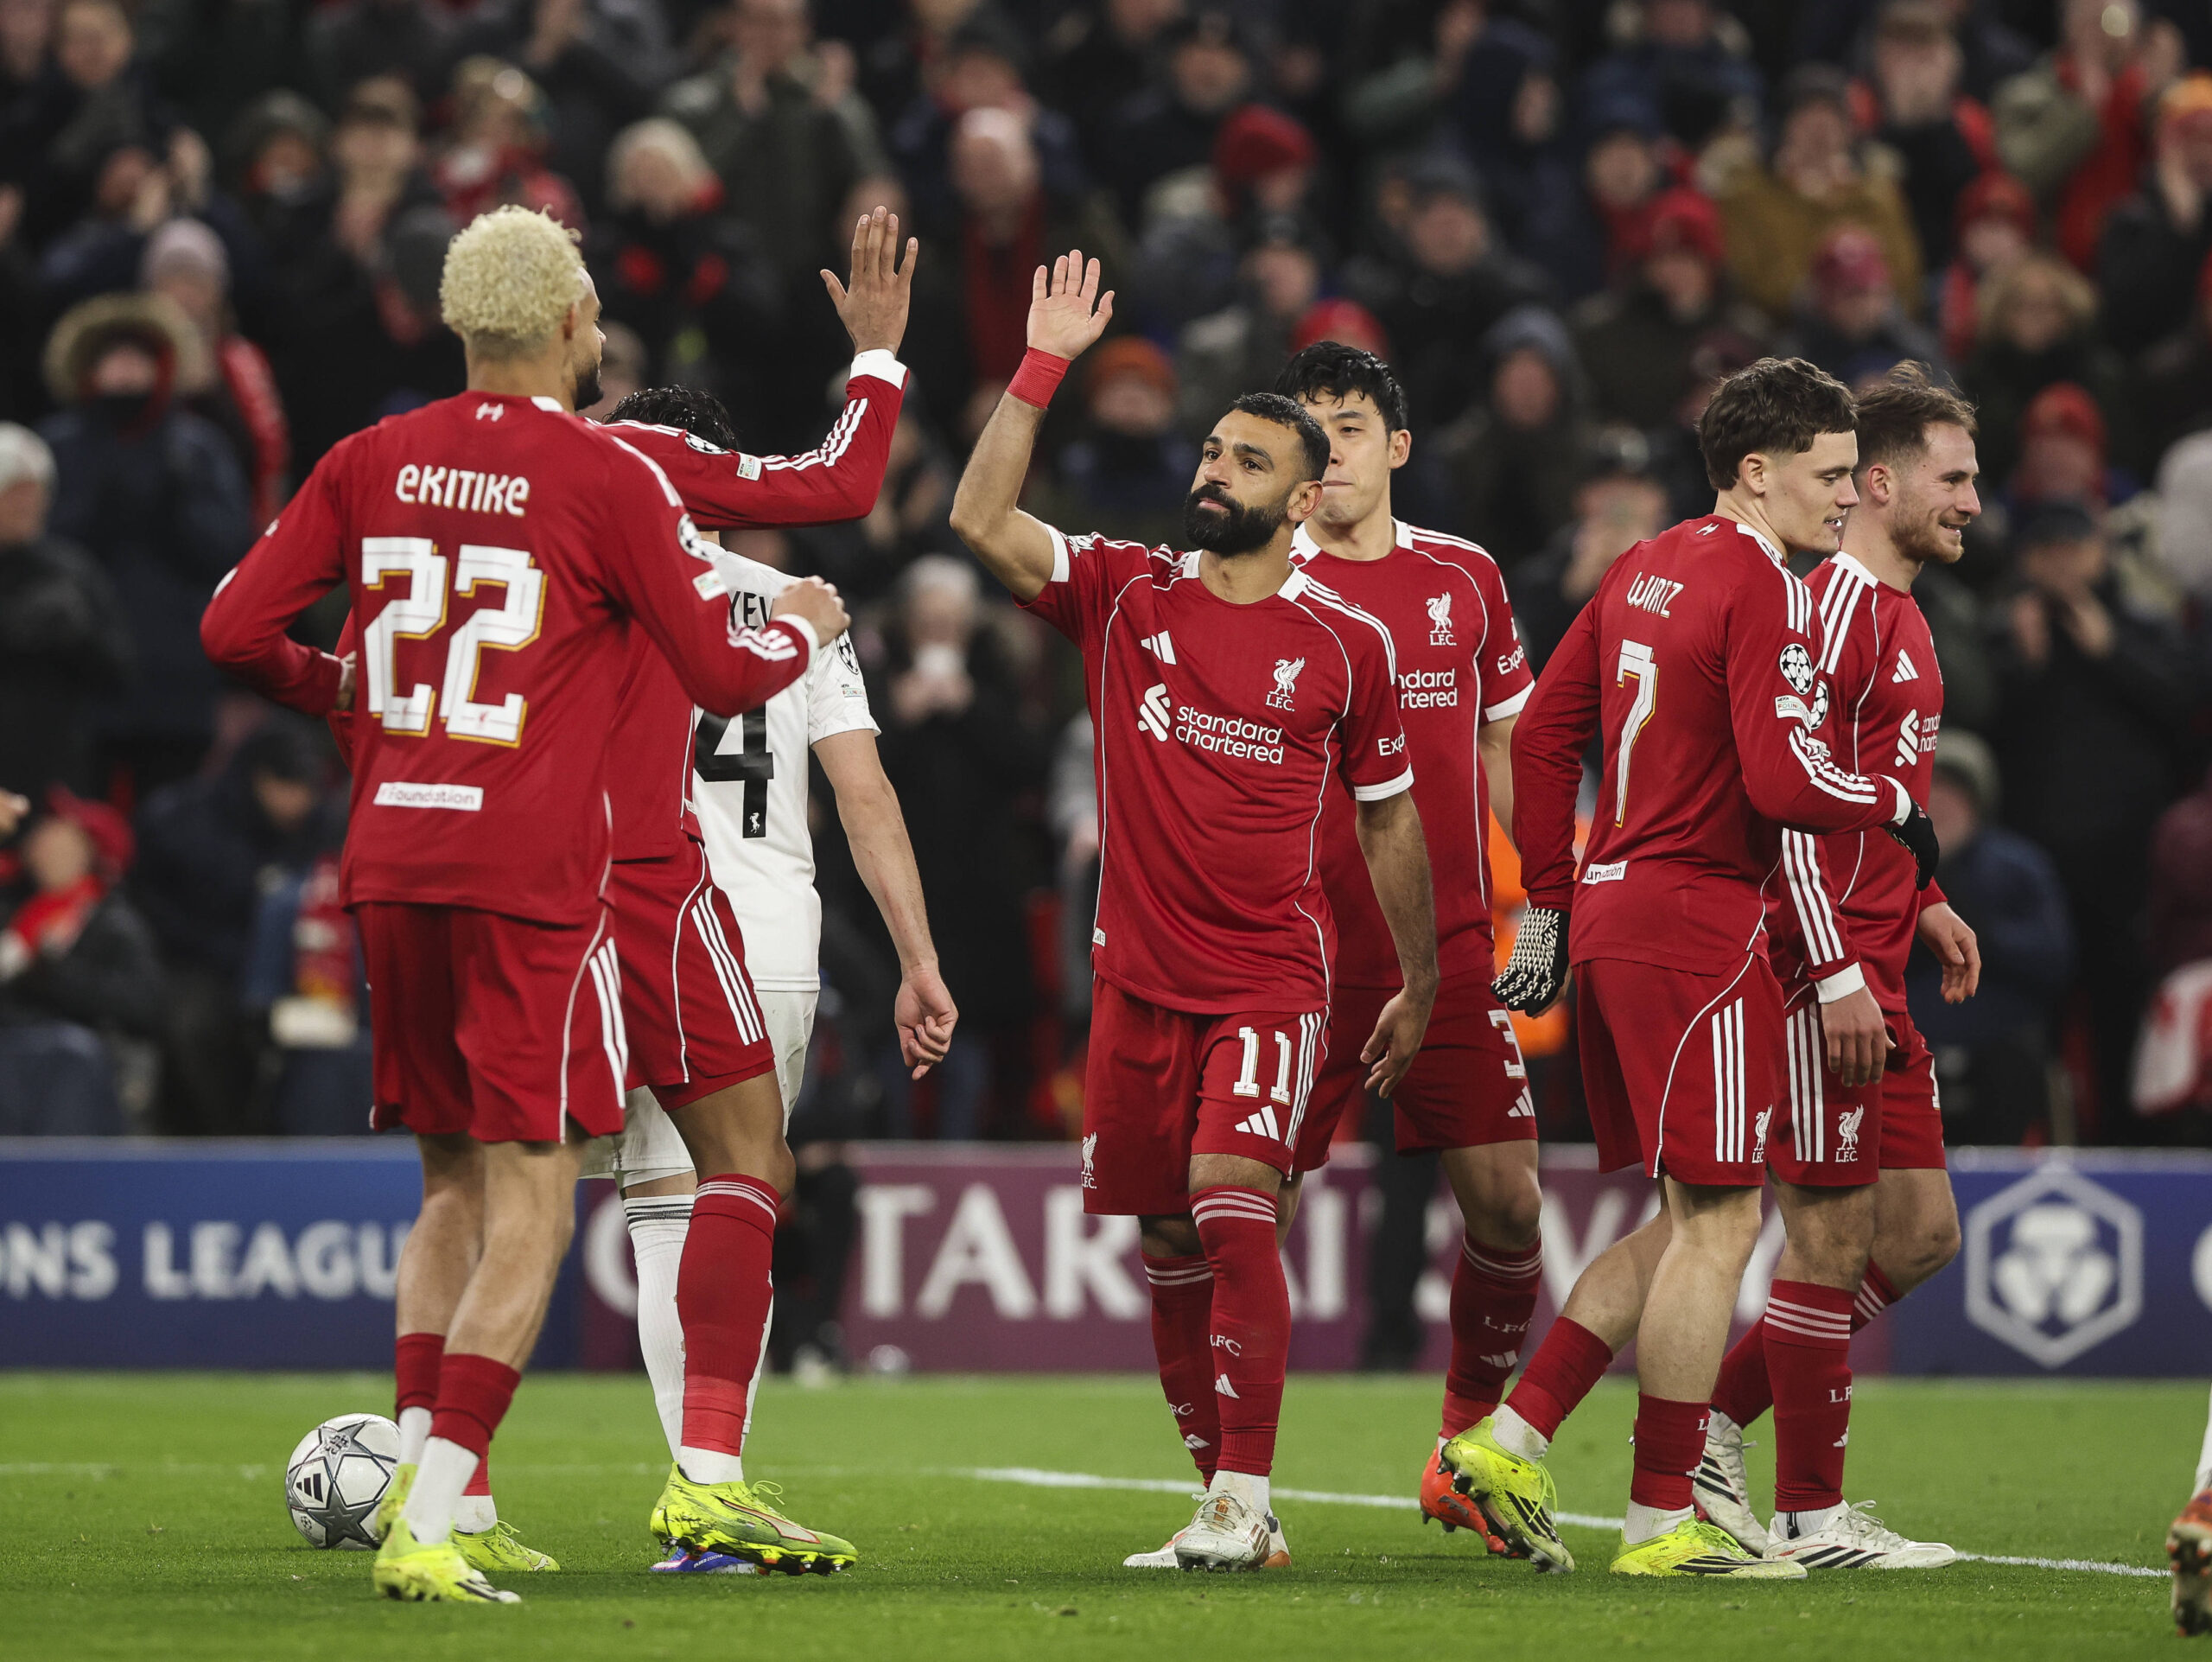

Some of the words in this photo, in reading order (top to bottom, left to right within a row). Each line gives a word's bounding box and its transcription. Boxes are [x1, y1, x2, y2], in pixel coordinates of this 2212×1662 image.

[729, 590, 776, 631] YEV
[1627, 571, 1684, 618] WIRTZ
[362, 537, 548, 748] 22
[1497, 645, 1524, 675] Expe
[1397, 668, 1456, 690] ndard
[1400, 687, 1459, 710] rtered
[1175, 724, 1285, 765] chartered
[1176, 705, 1283, 745] standard
[1377, 733, 1406, 757] Exp
[1615, 639, 1659, 828] 7
[695, 701, 774, 838] 4
[1233, 1026, 1293, 1106] 11
[0, 1219, 120, 1300] NS
[142, 1219, 421, 1299] LEAGU
